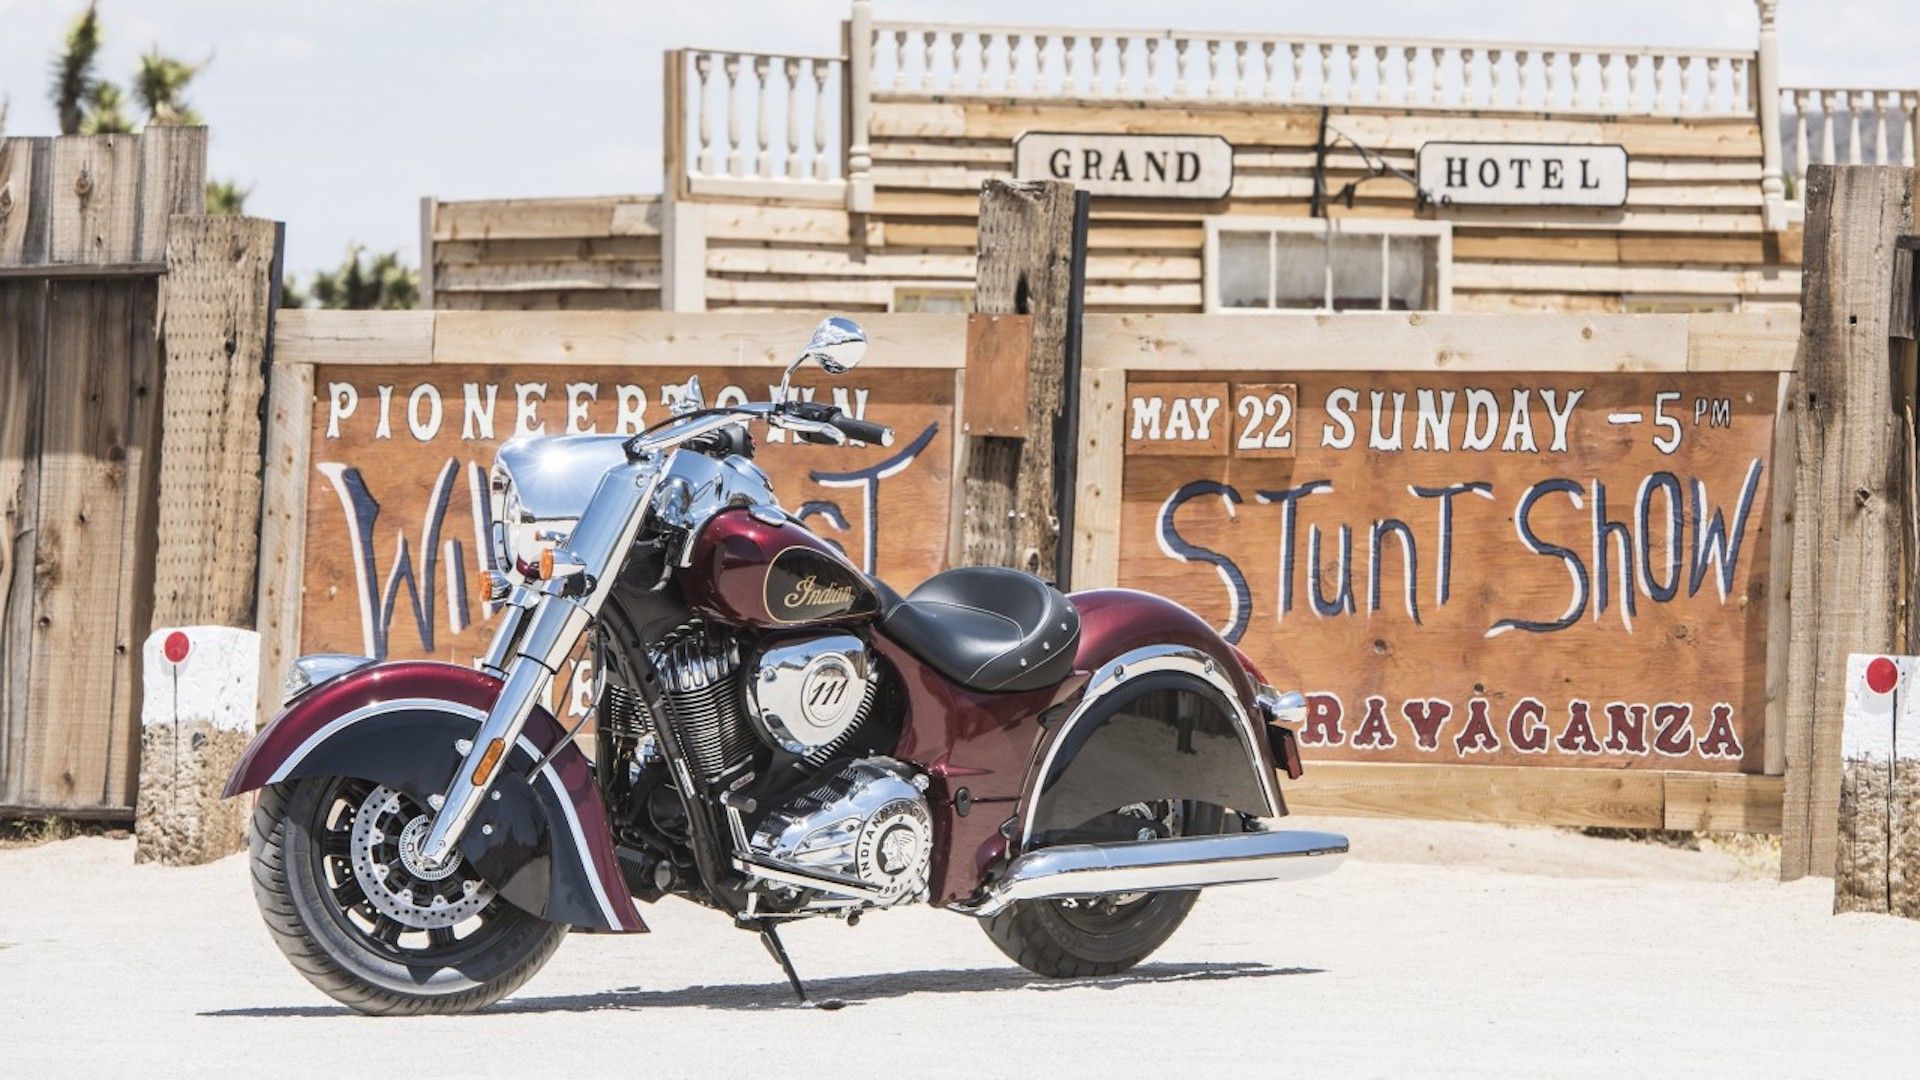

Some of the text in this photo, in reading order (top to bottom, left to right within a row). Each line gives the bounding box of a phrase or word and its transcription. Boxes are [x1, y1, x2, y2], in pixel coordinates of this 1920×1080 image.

[1049, 148, 1601, 190] GRAND HOTEL
[1131, 396, 1220, 441] MAY
[1237, 393, 1293, 450] 22
[1321, 387, 1586, 453] SUNDAY
[783, 575, 856, 608] Indian
[808, 679, 848, 706] 111
[1299, 692, 1744, 759] RAVAGANZA
[861, 816, 883, 878] INDIAN
